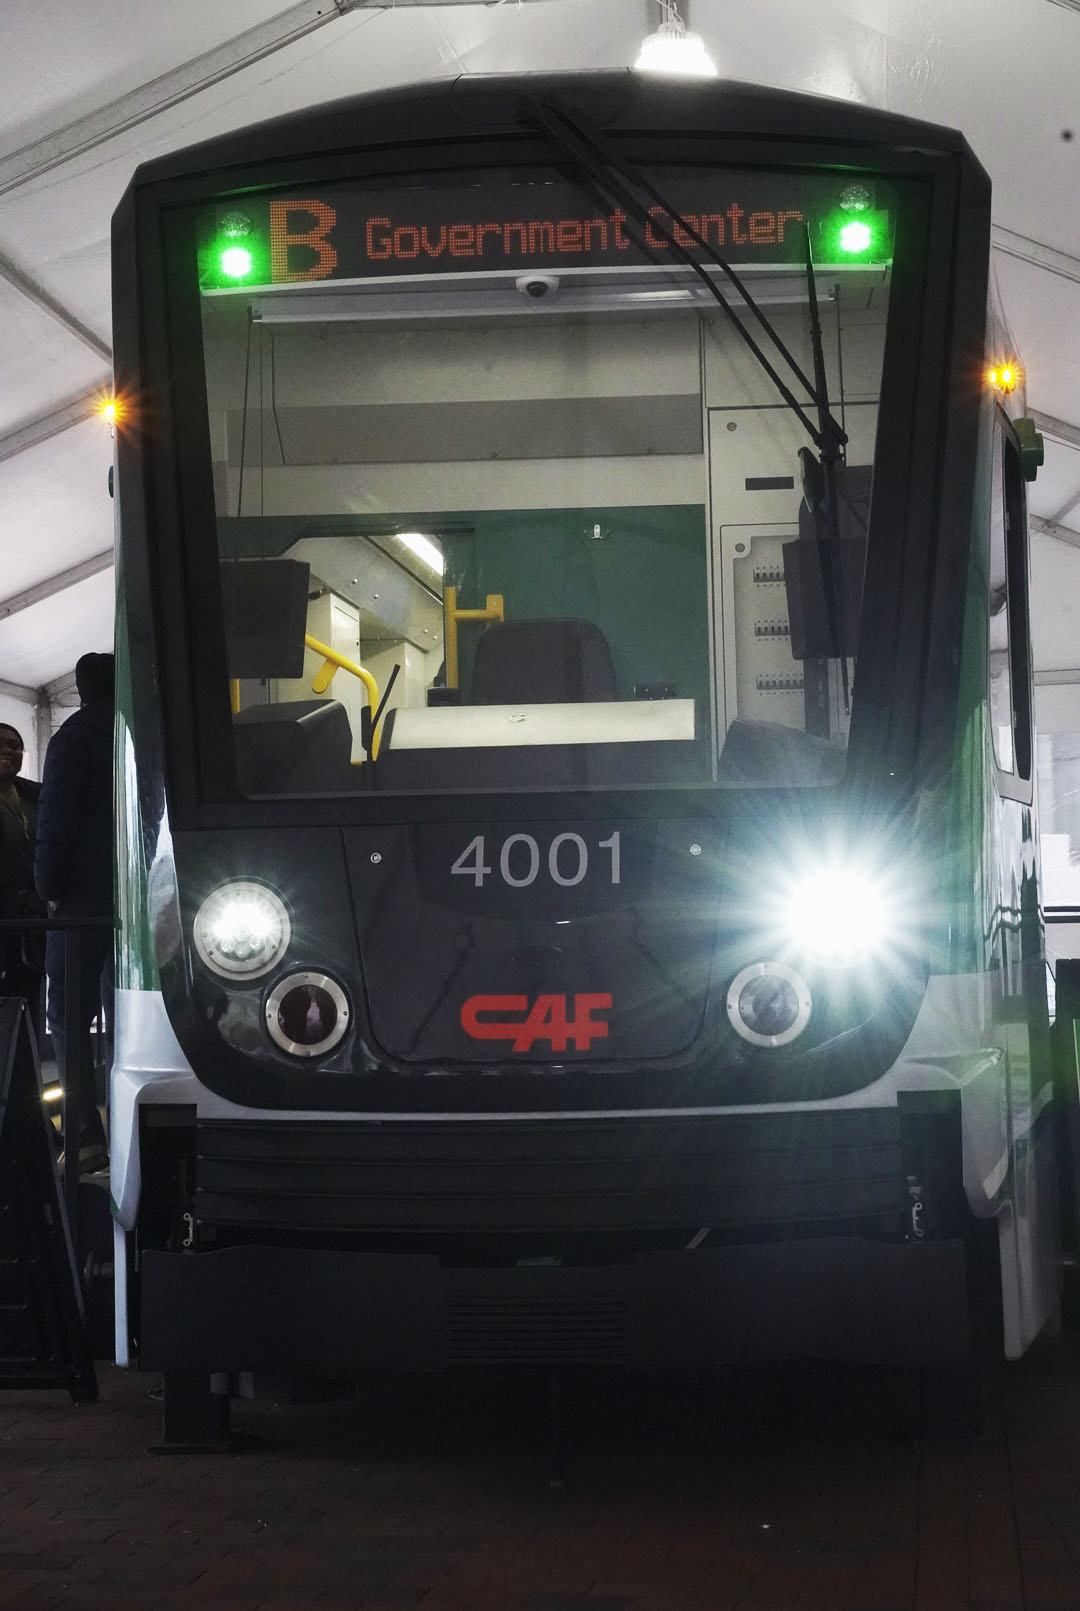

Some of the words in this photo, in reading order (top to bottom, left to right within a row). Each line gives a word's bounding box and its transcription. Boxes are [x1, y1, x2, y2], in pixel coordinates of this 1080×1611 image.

[269, 200, 338, 283] B
[365, 208, 630, 260] Government
[645, 202, 804, 249] Center
[450, 831, 621, 888] 4001
[460, 992, 613, 1053] CAF
